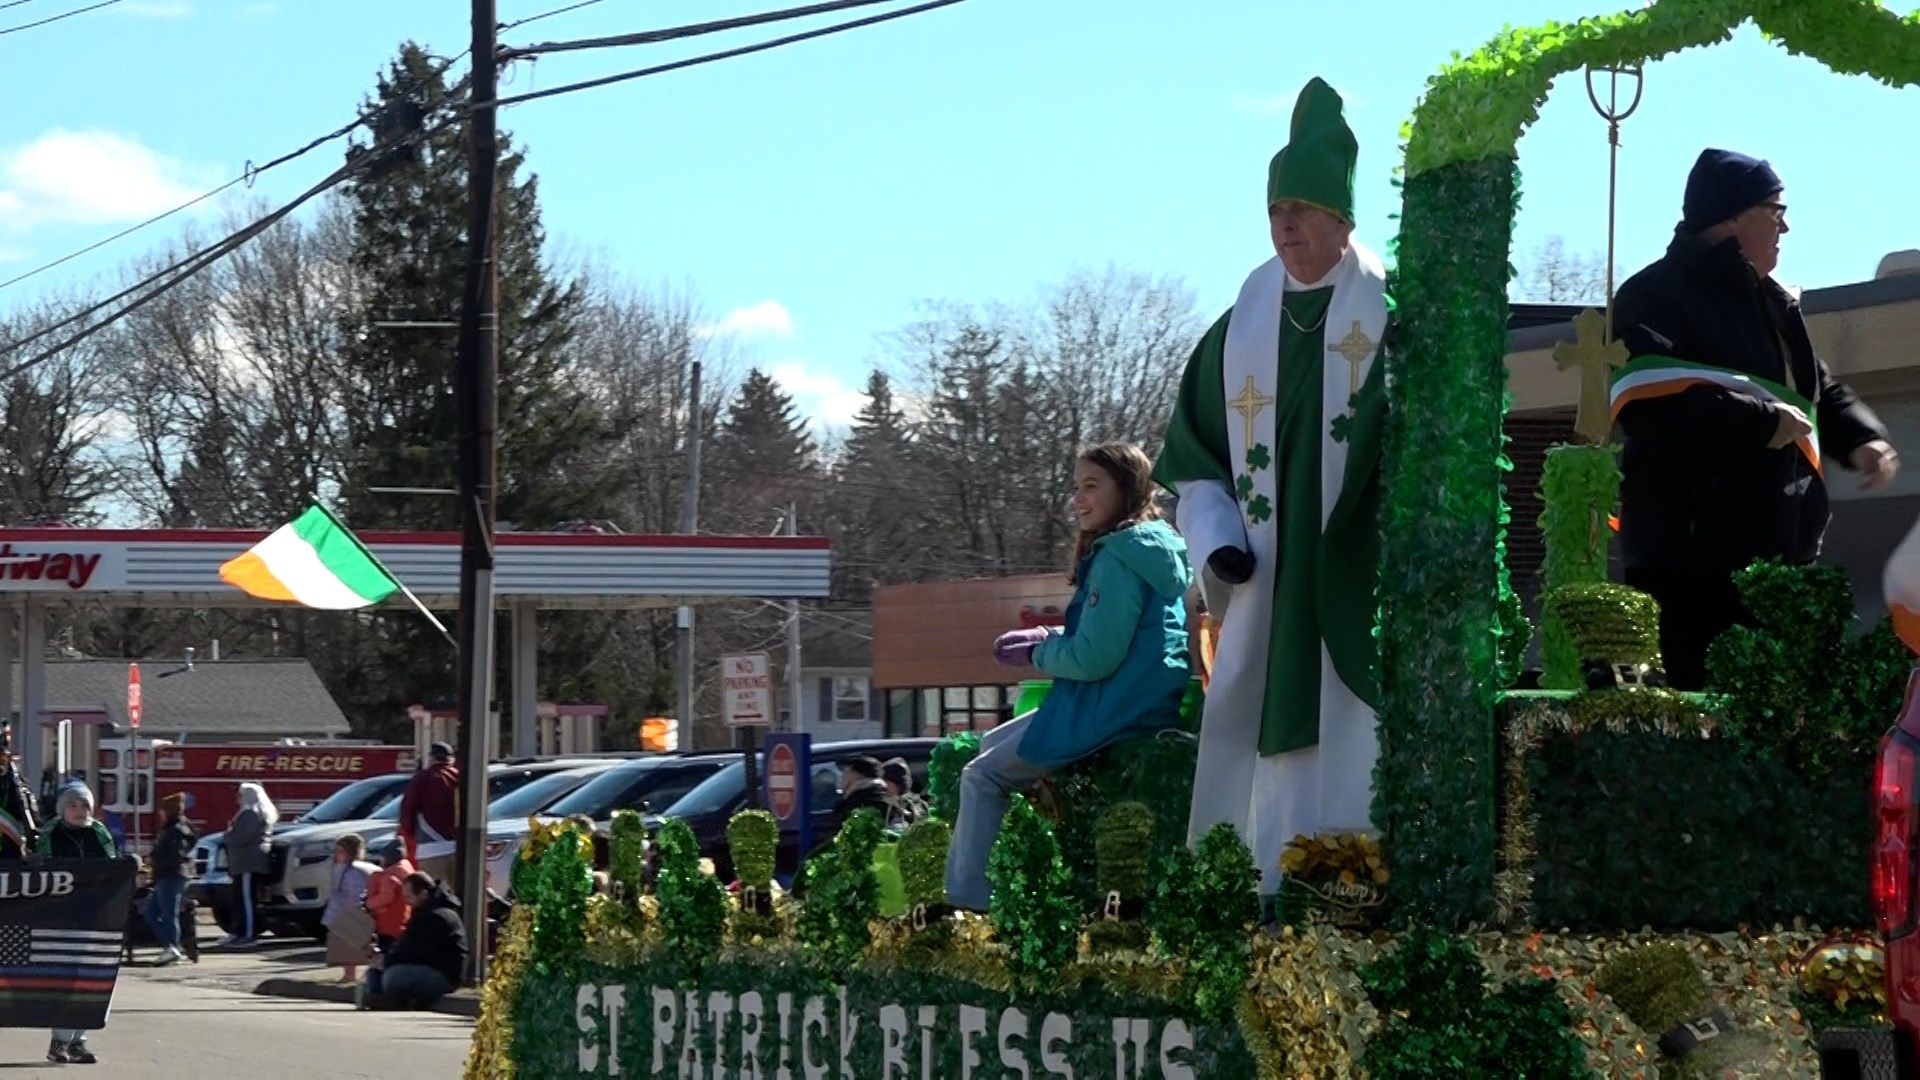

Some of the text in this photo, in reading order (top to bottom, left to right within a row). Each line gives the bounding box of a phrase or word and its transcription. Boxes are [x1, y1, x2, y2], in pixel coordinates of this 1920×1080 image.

[735, 660, 754, 674] NO
[724, 675, 768, 690] PARKING
[215, 755, 365, 772] FIRE-RESCUE
[575, 982, 626, 1076] ST
[650, 985, 860, 1080] PATRICK
